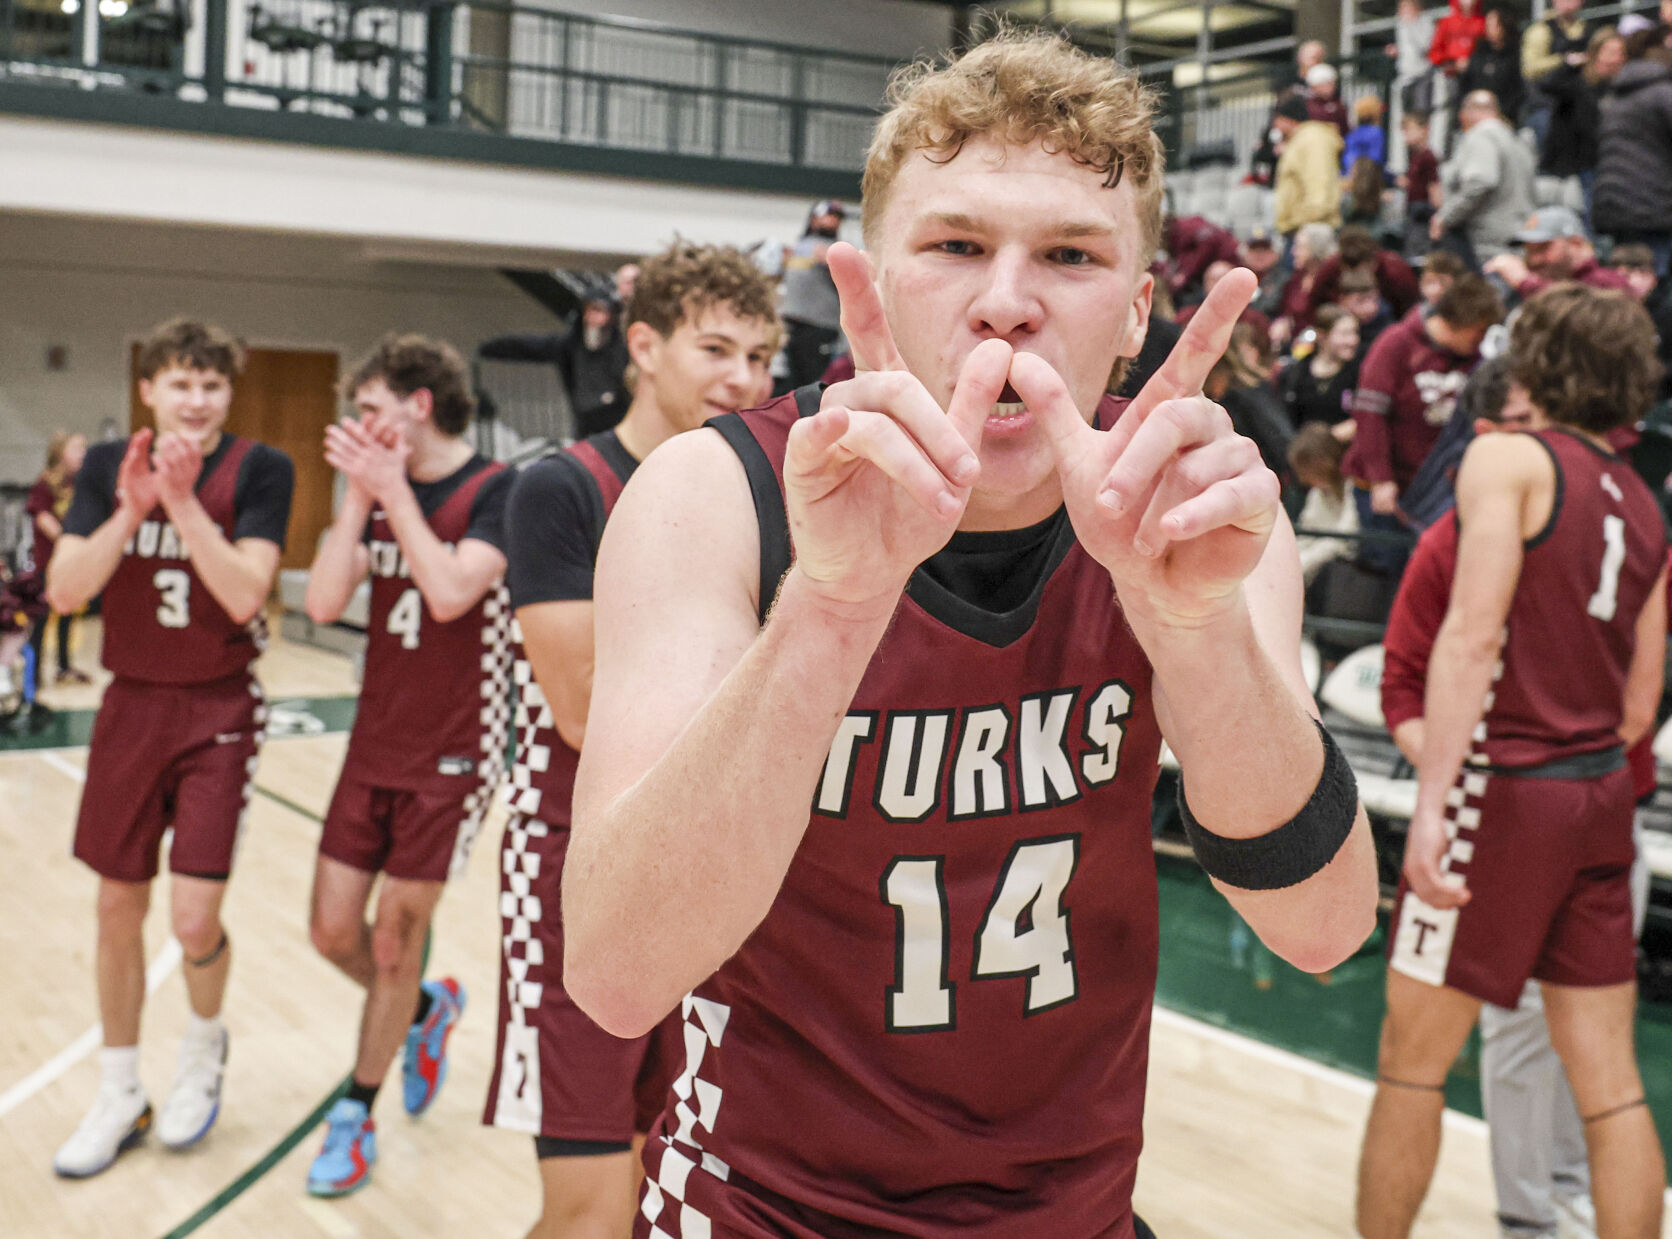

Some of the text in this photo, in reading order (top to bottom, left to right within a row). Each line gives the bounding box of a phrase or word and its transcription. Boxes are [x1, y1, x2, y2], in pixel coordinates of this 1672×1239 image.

[153, 567, 192, 629] 3
[1586, 513, 1627, 622] 1
[386, 587, 421, 651] 4
[812, 678, 1136, 824] TURKS
[877, 832, 1083, 1034] 14
[1412, 916, 1438, 957] T
